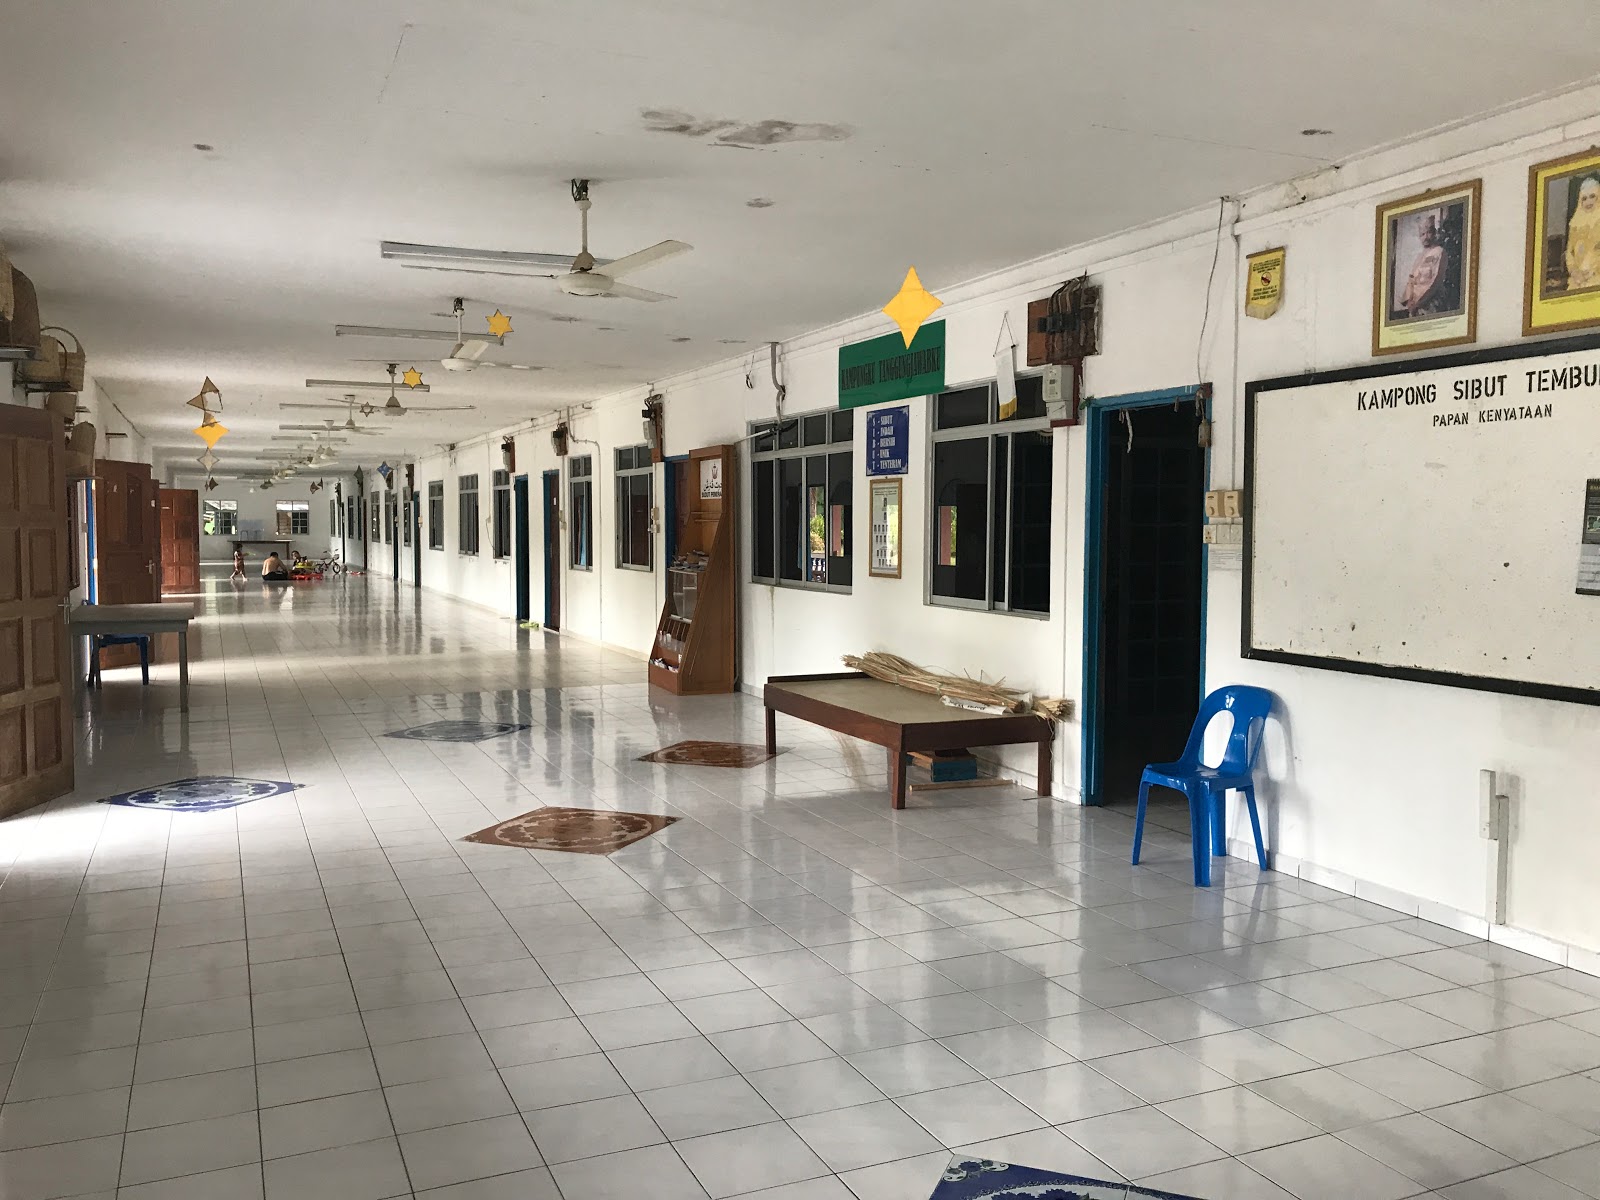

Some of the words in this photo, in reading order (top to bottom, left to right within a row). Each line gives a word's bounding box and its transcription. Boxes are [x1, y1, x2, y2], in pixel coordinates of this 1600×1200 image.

[1357, 384, 1437, 411] KAMPONG
[1453, 375, 1508, 401] SIBUT
[1525, 363, 1600, 393] TEMBU
[1432, 411, 1469, 427] PAPAN
[1478, 403, 1553, 423] KENYATAAN
[880, 459, 902, 470] TENTERAM
